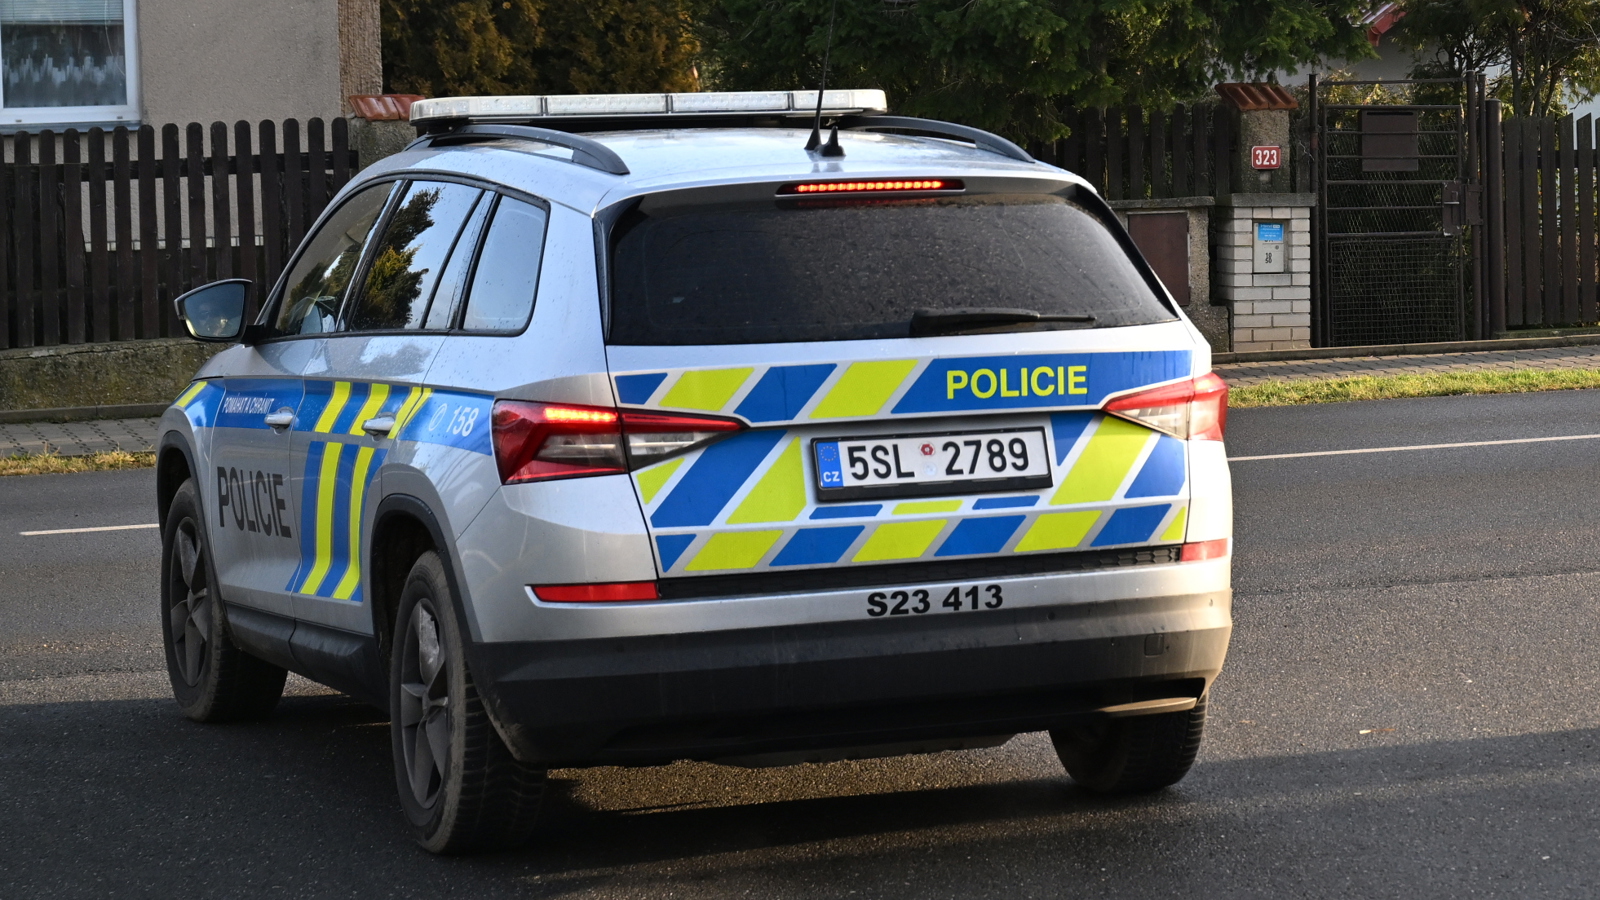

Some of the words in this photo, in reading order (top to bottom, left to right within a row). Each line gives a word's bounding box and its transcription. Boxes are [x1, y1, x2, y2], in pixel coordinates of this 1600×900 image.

[1255, 149, 1278, 166] 323
[946, 365, 1088, 400] POLICIE
[446, 405, 480, 437] 158
[847, 443, 915, 481] 5SL
[942, 437, 1029, 476] 2789
[823, 470, 841, 483] CZ
[216, 466, 292, 539] POLICIE
[867, 588, 931, 617] S23
[942, 584, 1004, 612] 413
